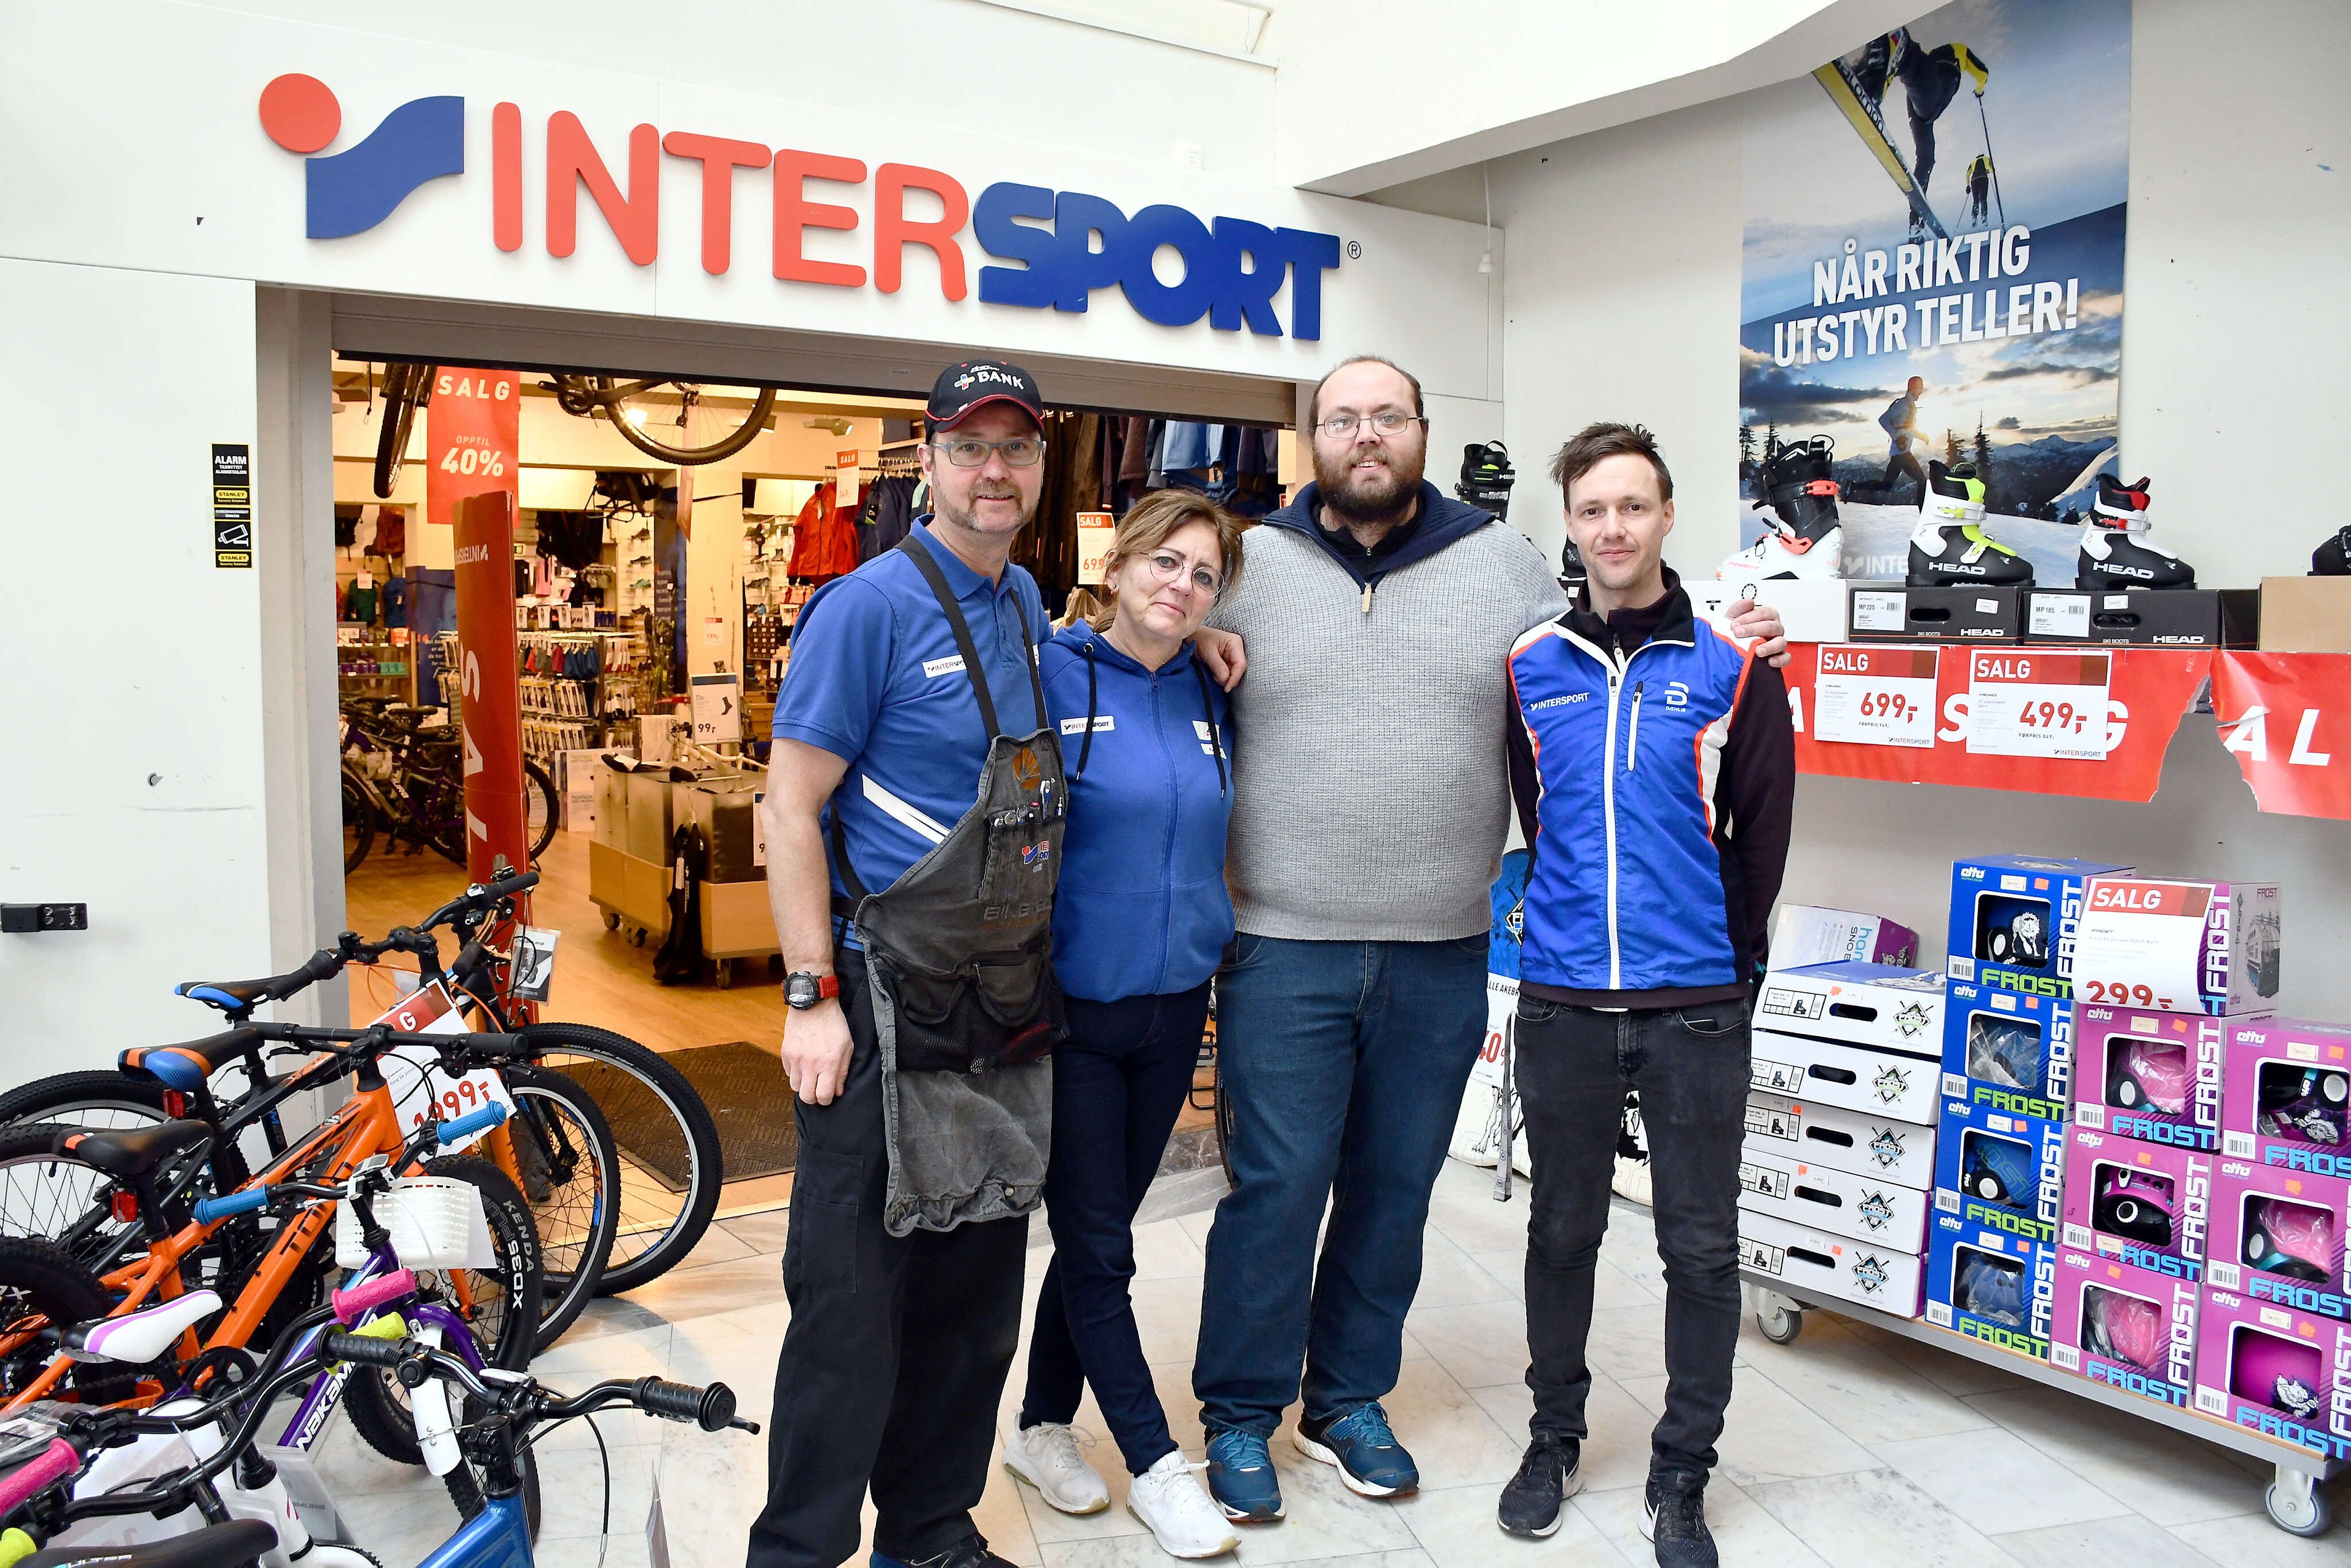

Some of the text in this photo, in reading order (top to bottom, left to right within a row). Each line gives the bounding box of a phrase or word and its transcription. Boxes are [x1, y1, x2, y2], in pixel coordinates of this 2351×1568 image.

[492, 102, 1340, 341] INTERSPORT
[1813, 225, 2030, 308] NÅR RIKTIG
[1774, 277, 2079, 367] UTSTYR TELLER!
[437, 376, 510, 401] SALG
[456, 435, 490, 446] OPPTIL
[215, 456, 247, 464] ALARM
[441, 447, 504, 478] 40%
[1080, 517, 1102, 526] SALG
[1929, 561, 1986, 575] HEAD
[2093, 562, 2154, 579] HEAD
[1961, 628, 2004, 636] HEAD
[2153, 635, 2204, 644] HEAD
[1822, 652, 1869, 672] SALG
[1976, 659, 2031, 678] SALG
[1538, 692, 1590, 710] INTERSPORT
[2093, 887, 2162, 910] SALG
[2057, 880, 2082, 977] FROST
[2205, 895, 2230, 994] FROST
[1981, 968, 2073, 999] FROST
[2047, 1003, 2071, 1102] FROST
[2195, 1020, 2221, 1128] FROST
[1974, 1086, 2065, 1120] FROST
[1872, 1142, 1904, 1154] FROST
[2112, 1115, 2215, 1148] FROST
[2038, 1124, 2063, 1223] FROST
[1861, 1205, 1894, 1217] FROST
[1966, 1204, 2055, 1242] FROST
[2182, 1155, 2209, 1261] FROST
[503, 1200, 535, 1272] KENDA
[1855, 1267, 1888, 1280] FROST
[2031, 1243, 2057, 1340] FROST
[1959, 1317, 2049, 1360] FROST
[2167, 1283, 2197, 1386] FROST
[2087, 1360, 2188, 1406] FROST
[2236, 1406, 2351, 1460] FROST
